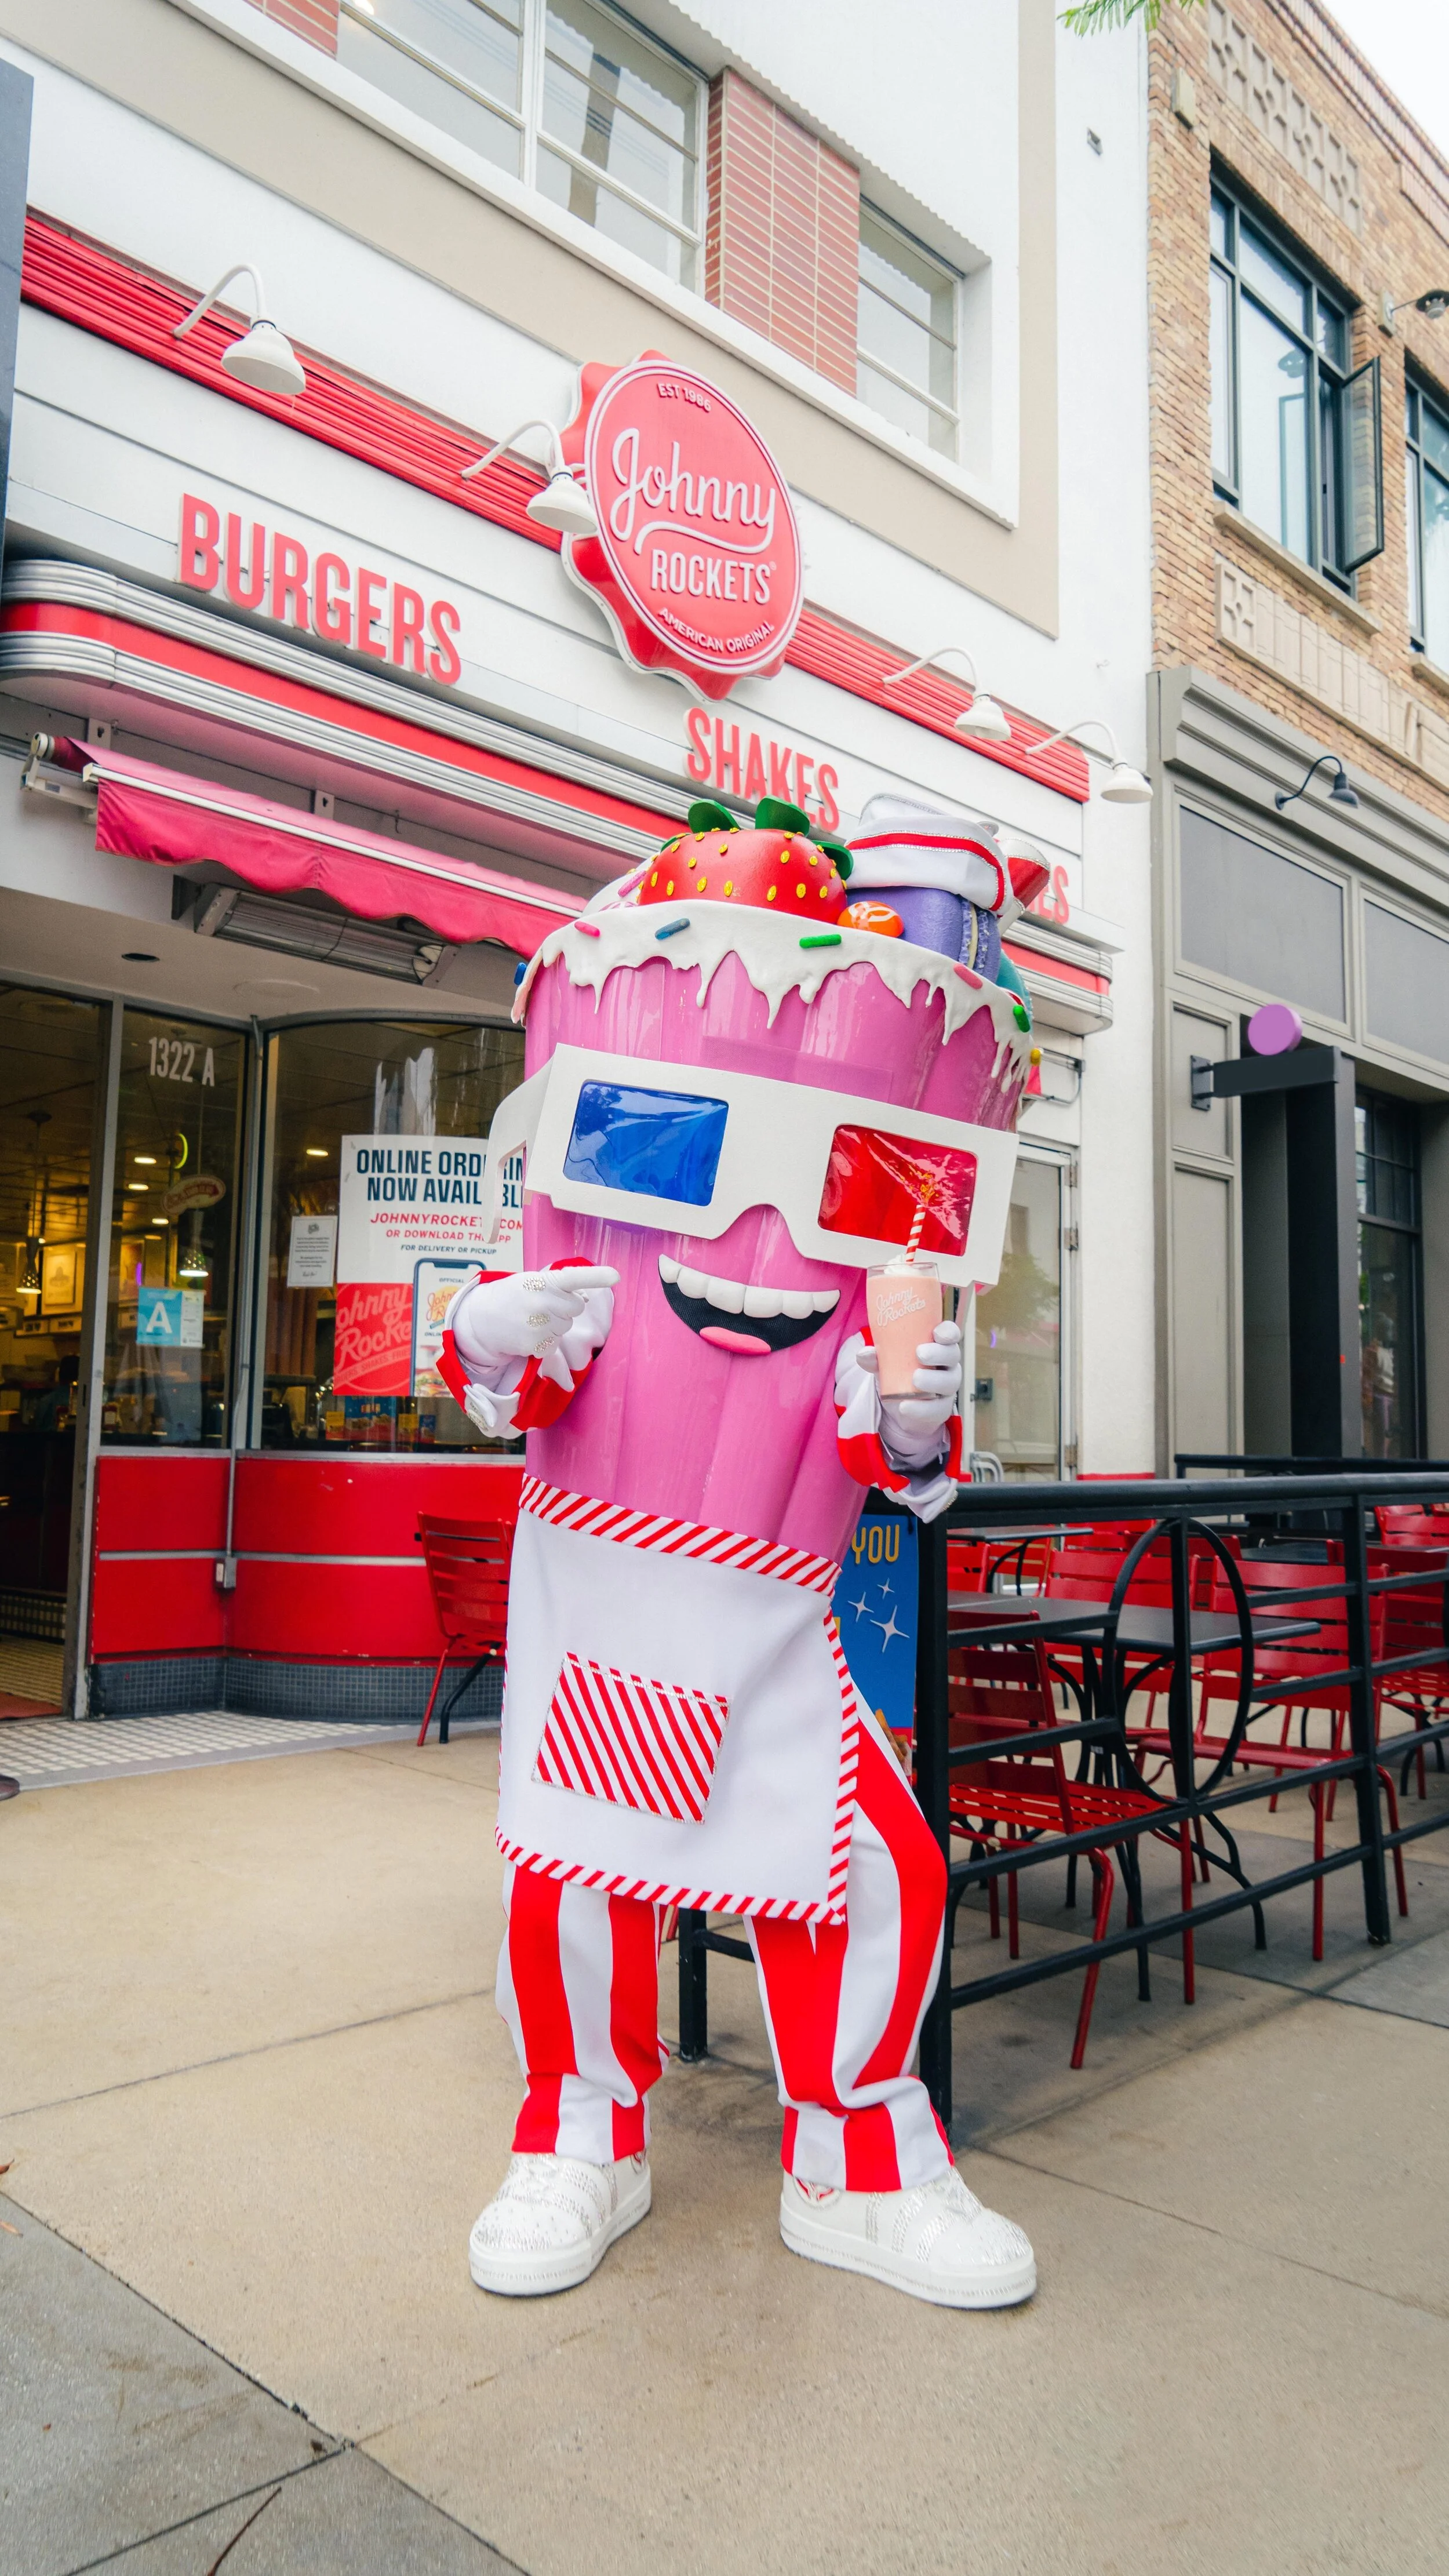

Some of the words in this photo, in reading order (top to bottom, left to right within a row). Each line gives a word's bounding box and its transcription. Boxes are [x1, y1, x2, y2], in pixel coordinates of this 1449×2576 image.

[657, 383, 680, 399] EST
[684, 387, 712, 412] 1986
[610, 428, 776, 555] Johnny
[177, 492, 462, 686] BURGERS
[657, 607, 724, 653] AMERICAN
[726, 620, 775, 654] ORIGINAL
[683, 707, 840, 833] SHAKES
[148, 1036, 195, 1083] 1322
[201, 1047, 215, 1087] A
[357, 1149, 432, 1174] ONLINE
[367, 1177, 418, 1202] NOW
[386, 1229, 401, 1238] OR
[405, 1229, 464, 1240] DOWNLOAD
[468, 1232, 485, 1242] TH
[418, 1245, 456, 1253] DELIVERY
[145, 1301, 173, 1334] A
[336, 1284, 412, 1326] ohnny
[876, 1287, 918, 1327] Johnny
[882, 1297, 926, 1327] Rockets
[852, 1525, 900, 1564] YOU
